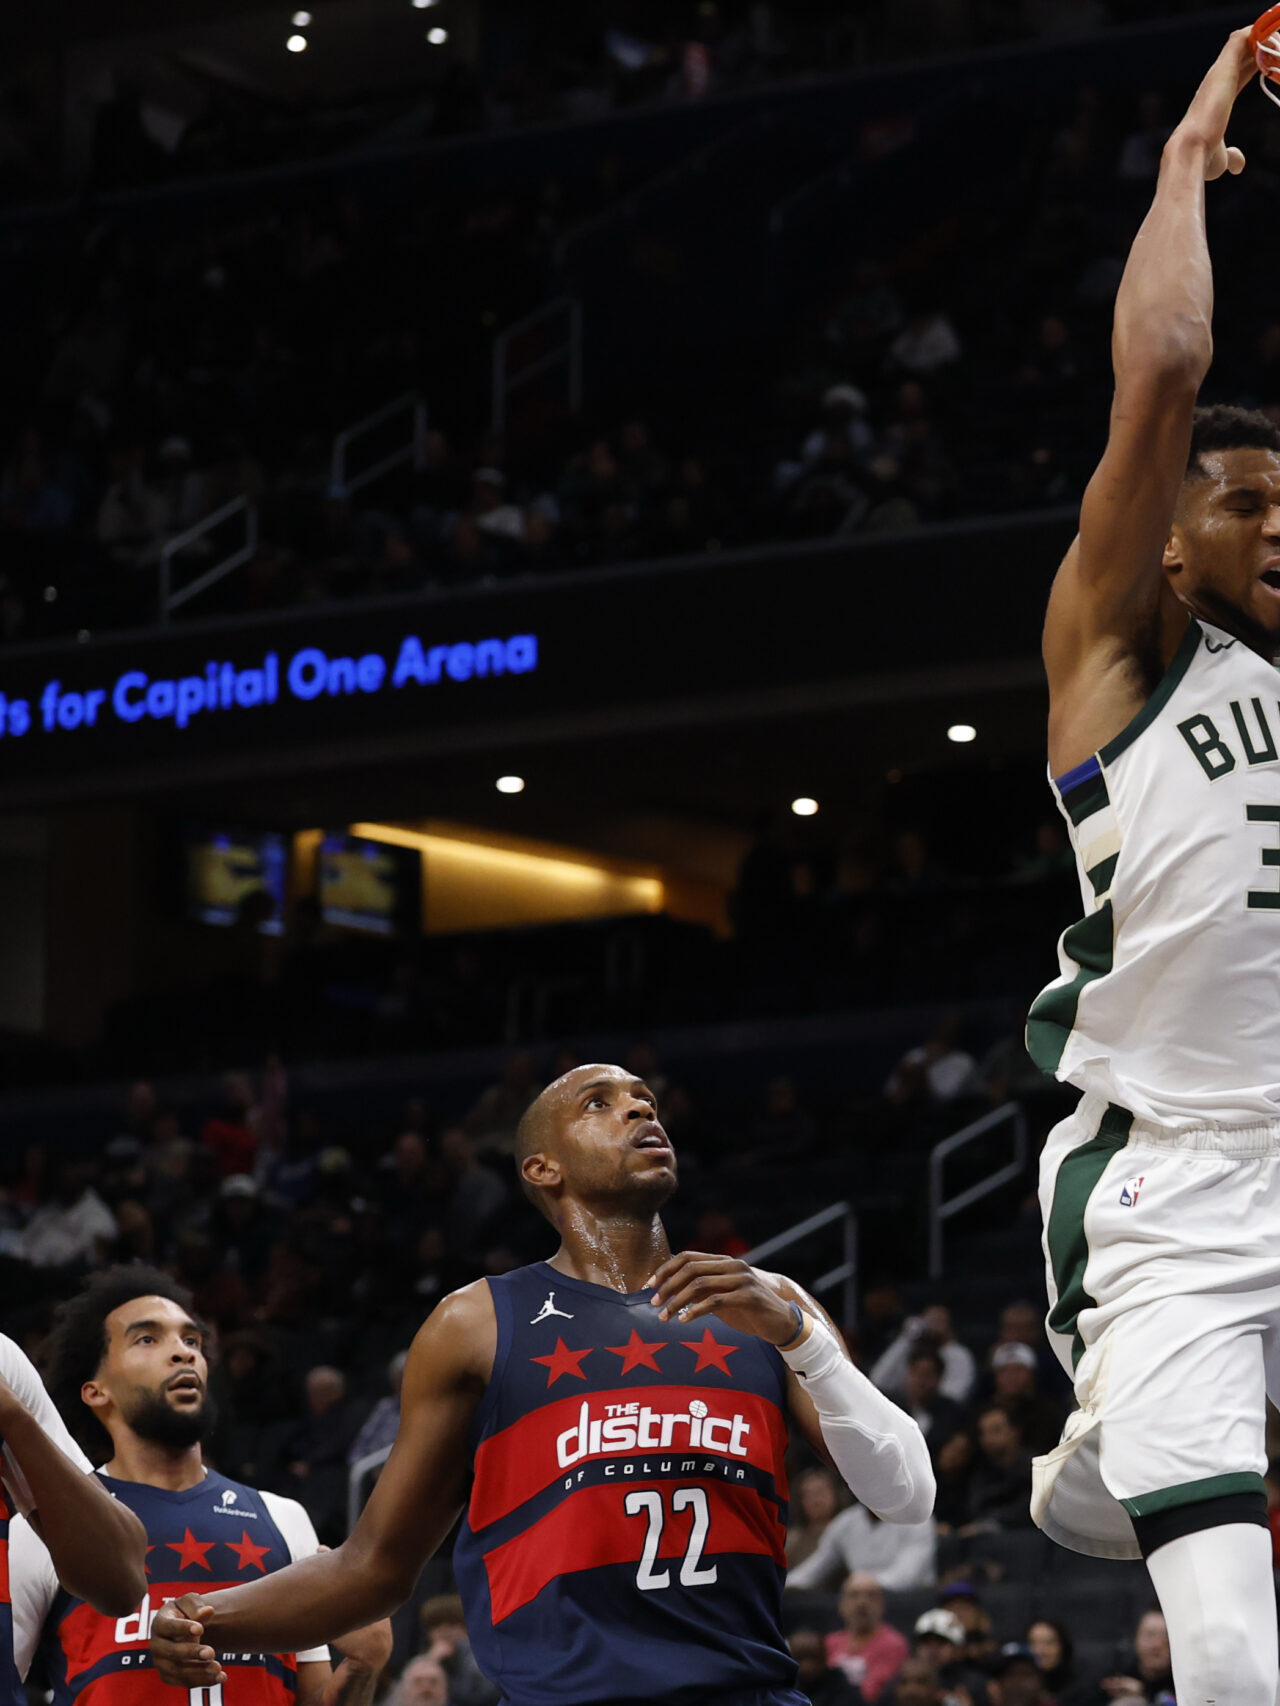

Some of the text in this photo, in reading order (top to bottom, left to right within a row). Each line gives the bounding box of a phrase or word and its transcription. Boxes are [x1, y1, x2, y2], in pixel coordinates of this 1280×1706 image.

[39, 680, 107, 731] for
[111, 652, 280, 729] Capital
[287, 647, 387, 701] One
[391, 634, 538, 688] Arena
[556, 1399, 751, 1469] district
[604, 1402, 640, 1418] THE
[564, 1460, 746, 1490] OF COLUMBIA
[623, 1487, 718, 1591] 22
[121, 1655, 146, 1665] OF
